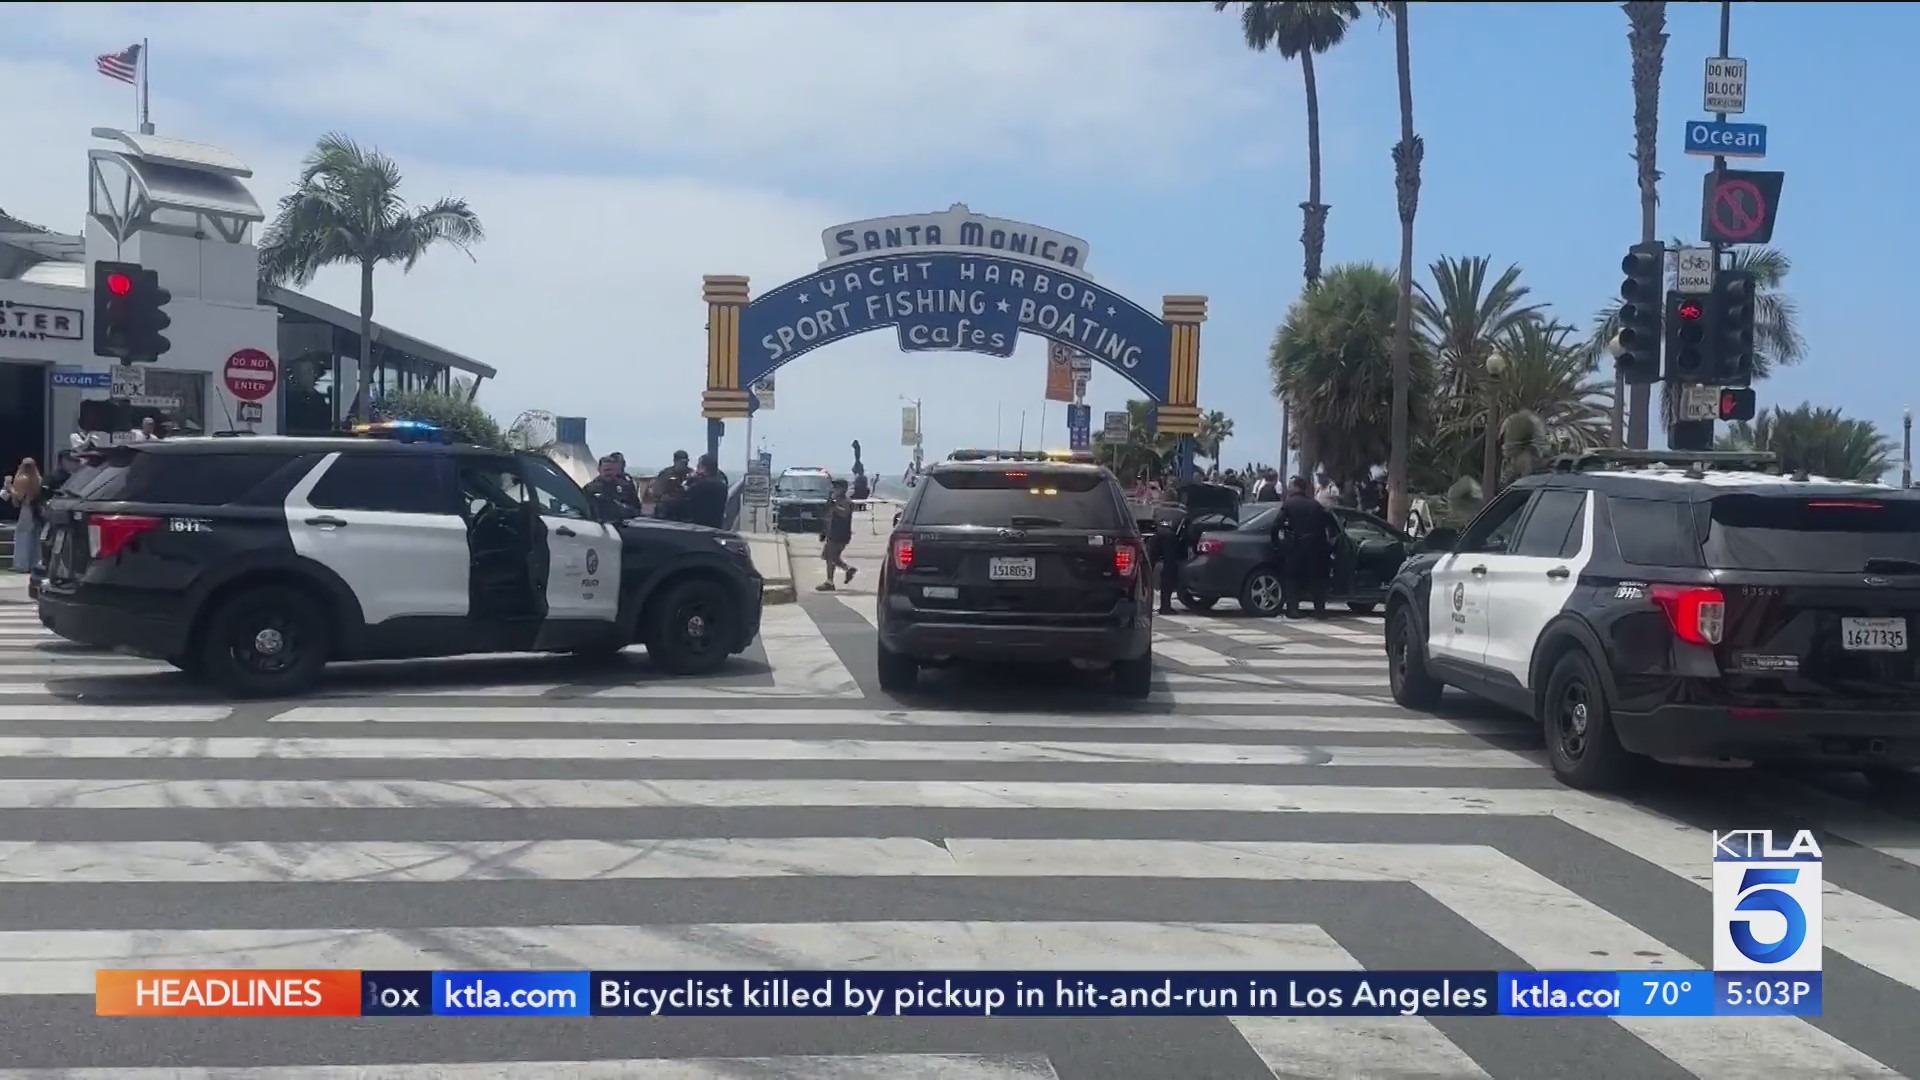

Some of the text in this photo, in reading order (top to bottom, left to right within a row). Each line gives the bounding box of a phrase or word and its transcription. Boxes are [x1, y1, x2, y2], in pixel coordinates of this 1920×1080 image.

[1708, 65, 1743, 78] DO NOT
[1708, 82, 1743, 96] BLOCK
[1692, 125, 1759, 146] Ocean
[836, 221, 1078, 267] SANTA MONICA
[819, 262, 1096, 311] YACHT HARBOR
[1679, 277, 1710, 286] SIGNAL
[762, 289, 1142, 369] SPORT FISHING BOATING
[232, 357, 269, 369] DO NOT
[54, 374, 92, 386] Ocean
[234, 381, 266, 390] ENTER
[1848, 630, 1903, 647] 1627335
